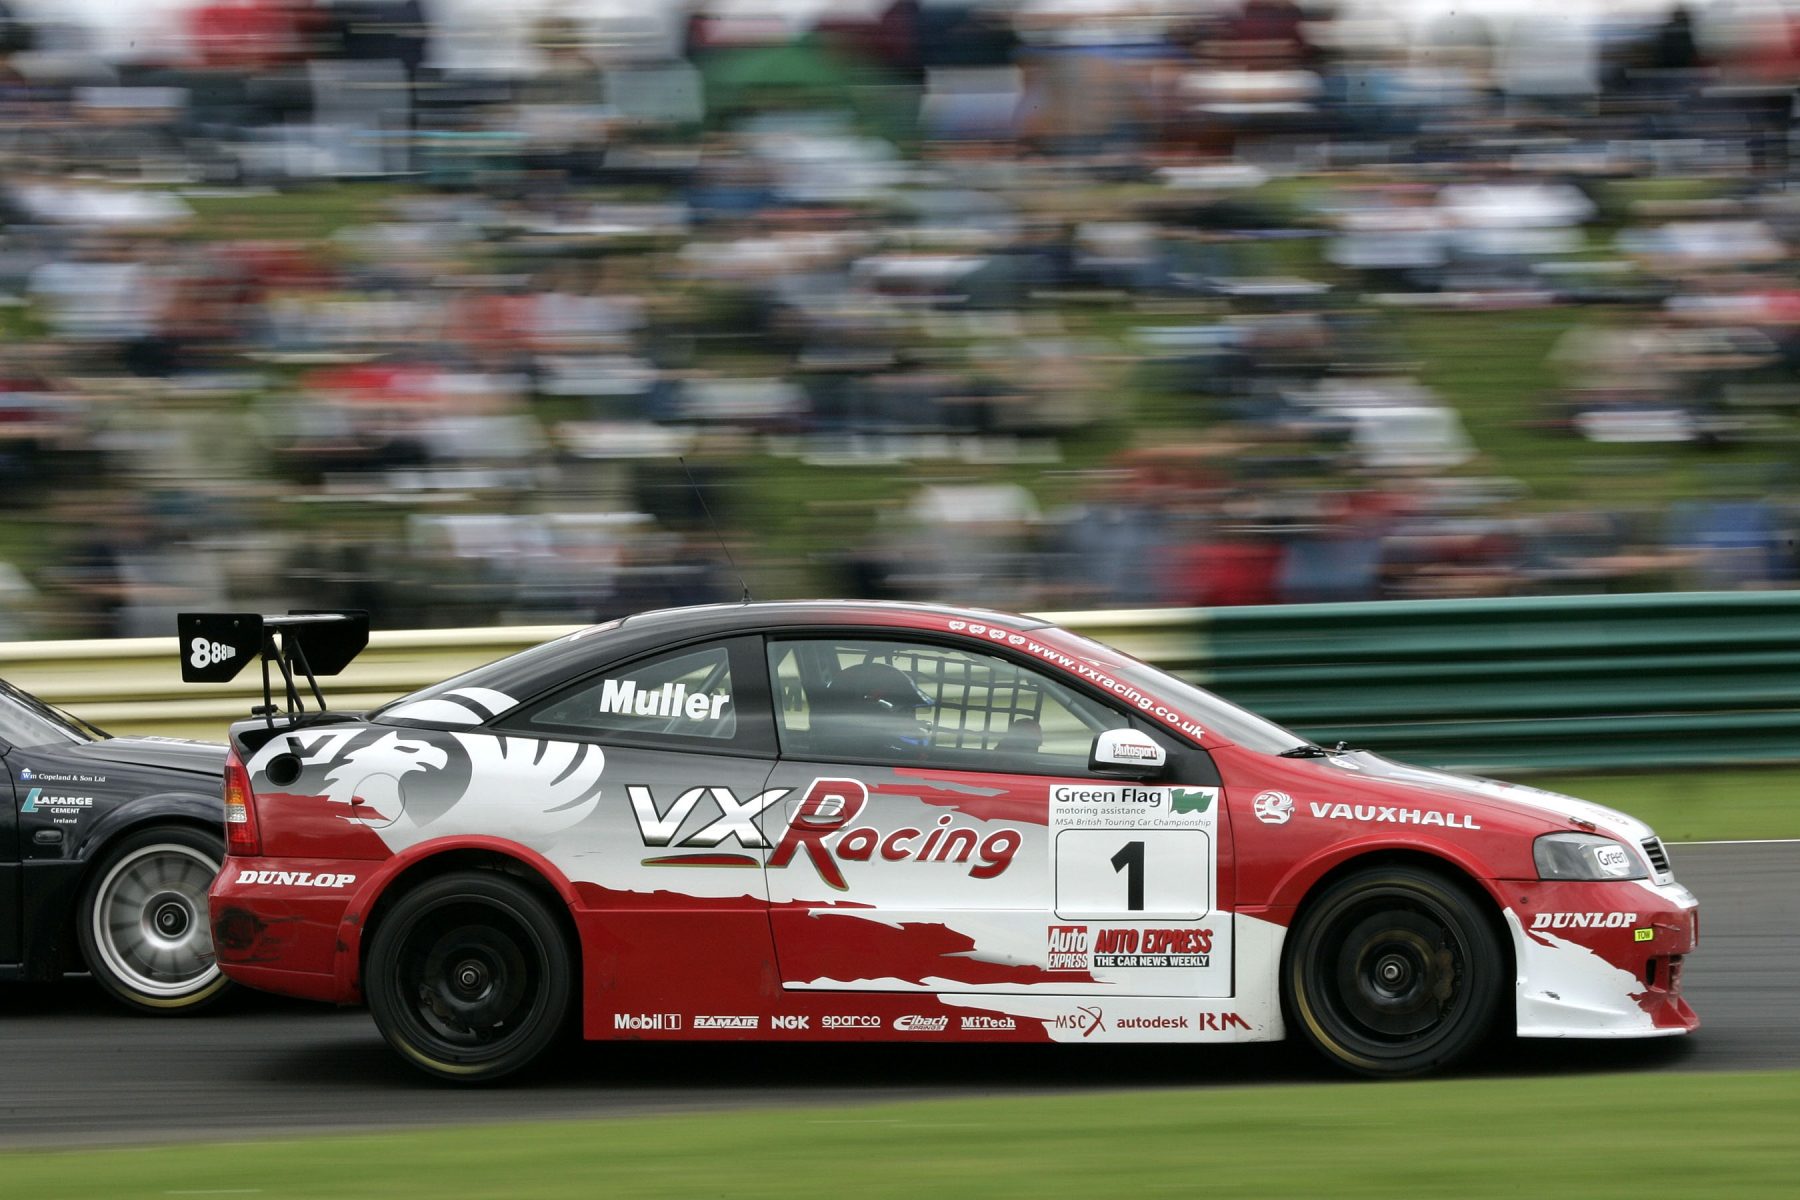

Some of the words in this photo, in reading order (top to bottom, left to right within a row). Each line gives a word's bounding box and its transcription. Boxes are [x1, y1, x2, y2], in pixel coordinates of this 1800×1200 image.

[1028, 642, 1205, 740] www.vxracing.co.uk
[600, 679, 730, 720] Muller
[1114, 744, 1157, 758] Autosport
[39, 773, 71, 781] Copeland
[34, 796, 93, 806] LAFARGE
[1055, 788, 1115, 803] Green
[1122, 788, 1162, 808] Flag
[1056, 807, 1098, 816] motoring
[1310, 802, 1481, 830] VAUXHALL
[1105, 819, 1135, 828] Touring
[1153, 819, 1212, 828] Championship
[624, 784, 800, 849] VX
[766, 777, 1023, 892] Racing
[1597, 850, 1628, 866] Green
[235, 870, 356, 889] DUNLOP
[1110, 841, 1145, 911] 1
[1531, 912, 1637, 929] DUNLOP
[1050, 928, 1087, 953] Auto
[1094, 929, 1139, 954] AUTO
[1141, 929, 1214, 954] EXPRESS
[1637, 931, 1651, 940] TOW
[1049, 955, 1087, 968] EXPRESS
[1096, 956, 1114, 966] THE
[1117, 956, 1137, 966] CAR
[1139, 956, 1168, 966] NEWS
[1170, 956, 1208, 966] WEEKLY
[614, 1014, 662, 1029] Mobil
[694, 1016, 759, 1028] RAMAIR
[771, 1016, 810, 1029] NGK
[822, 1015, 881, 1029] sparco
[961, 1017, 1016, 1028] MiTech
[1117, 1016, 1188, 1028] autodesk
[1200, 1012, 1253, 1030] RM
